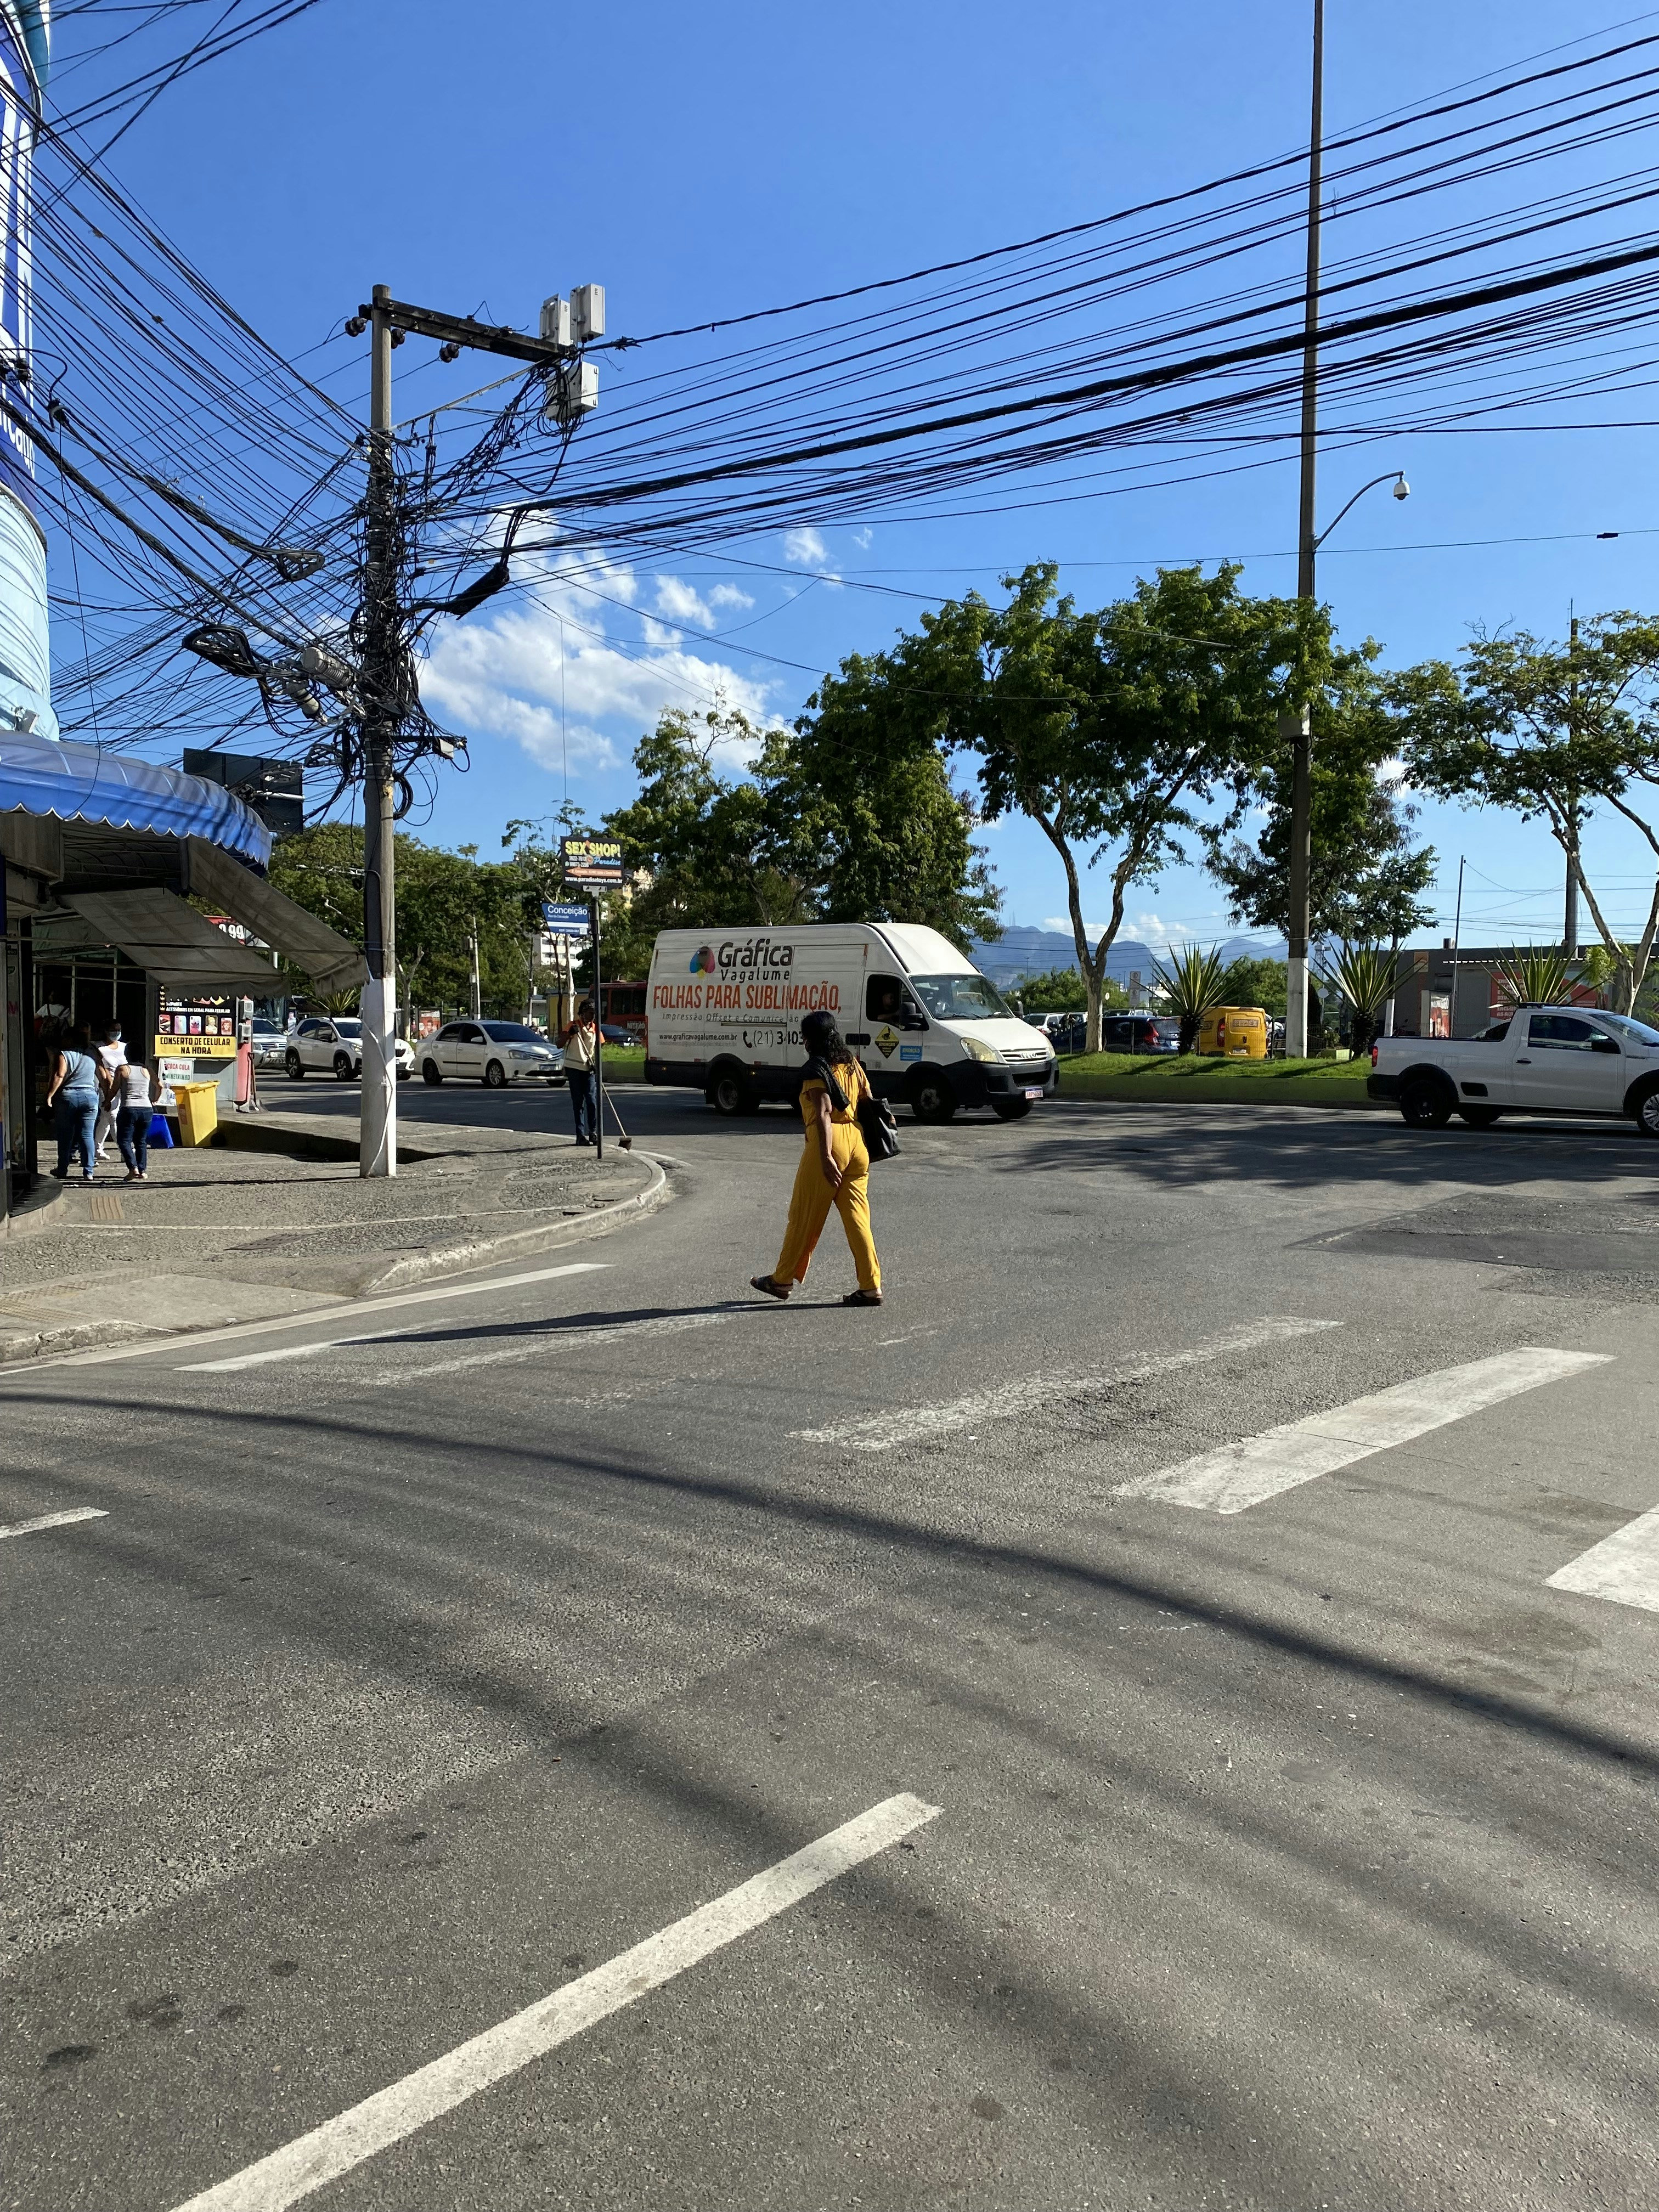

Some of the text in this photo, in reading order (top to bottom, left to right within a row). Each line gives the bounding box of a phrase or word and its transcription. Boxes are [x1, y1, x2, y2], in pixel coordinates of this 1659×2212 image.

[565, 841, 621, 857] SEX SHOP!
[548, 905, 588, 916] Conceição
[718, 938, 793, 967] Gráfica
[720, 967, 790, 984] Vagalume
[653, 980, 842, 1013] FOLHAS PARA SUBLIMAÇÃO,
[662, 1013, 702, 1021] Impressão
[706, 1013, 731, 1022] Offset
[160, 1037, 192, 1045] CONSERTO
[659, 1033, 737, 1041] www.graficavagalume.com.br
[753, 1030, 774, 1047] (21)
